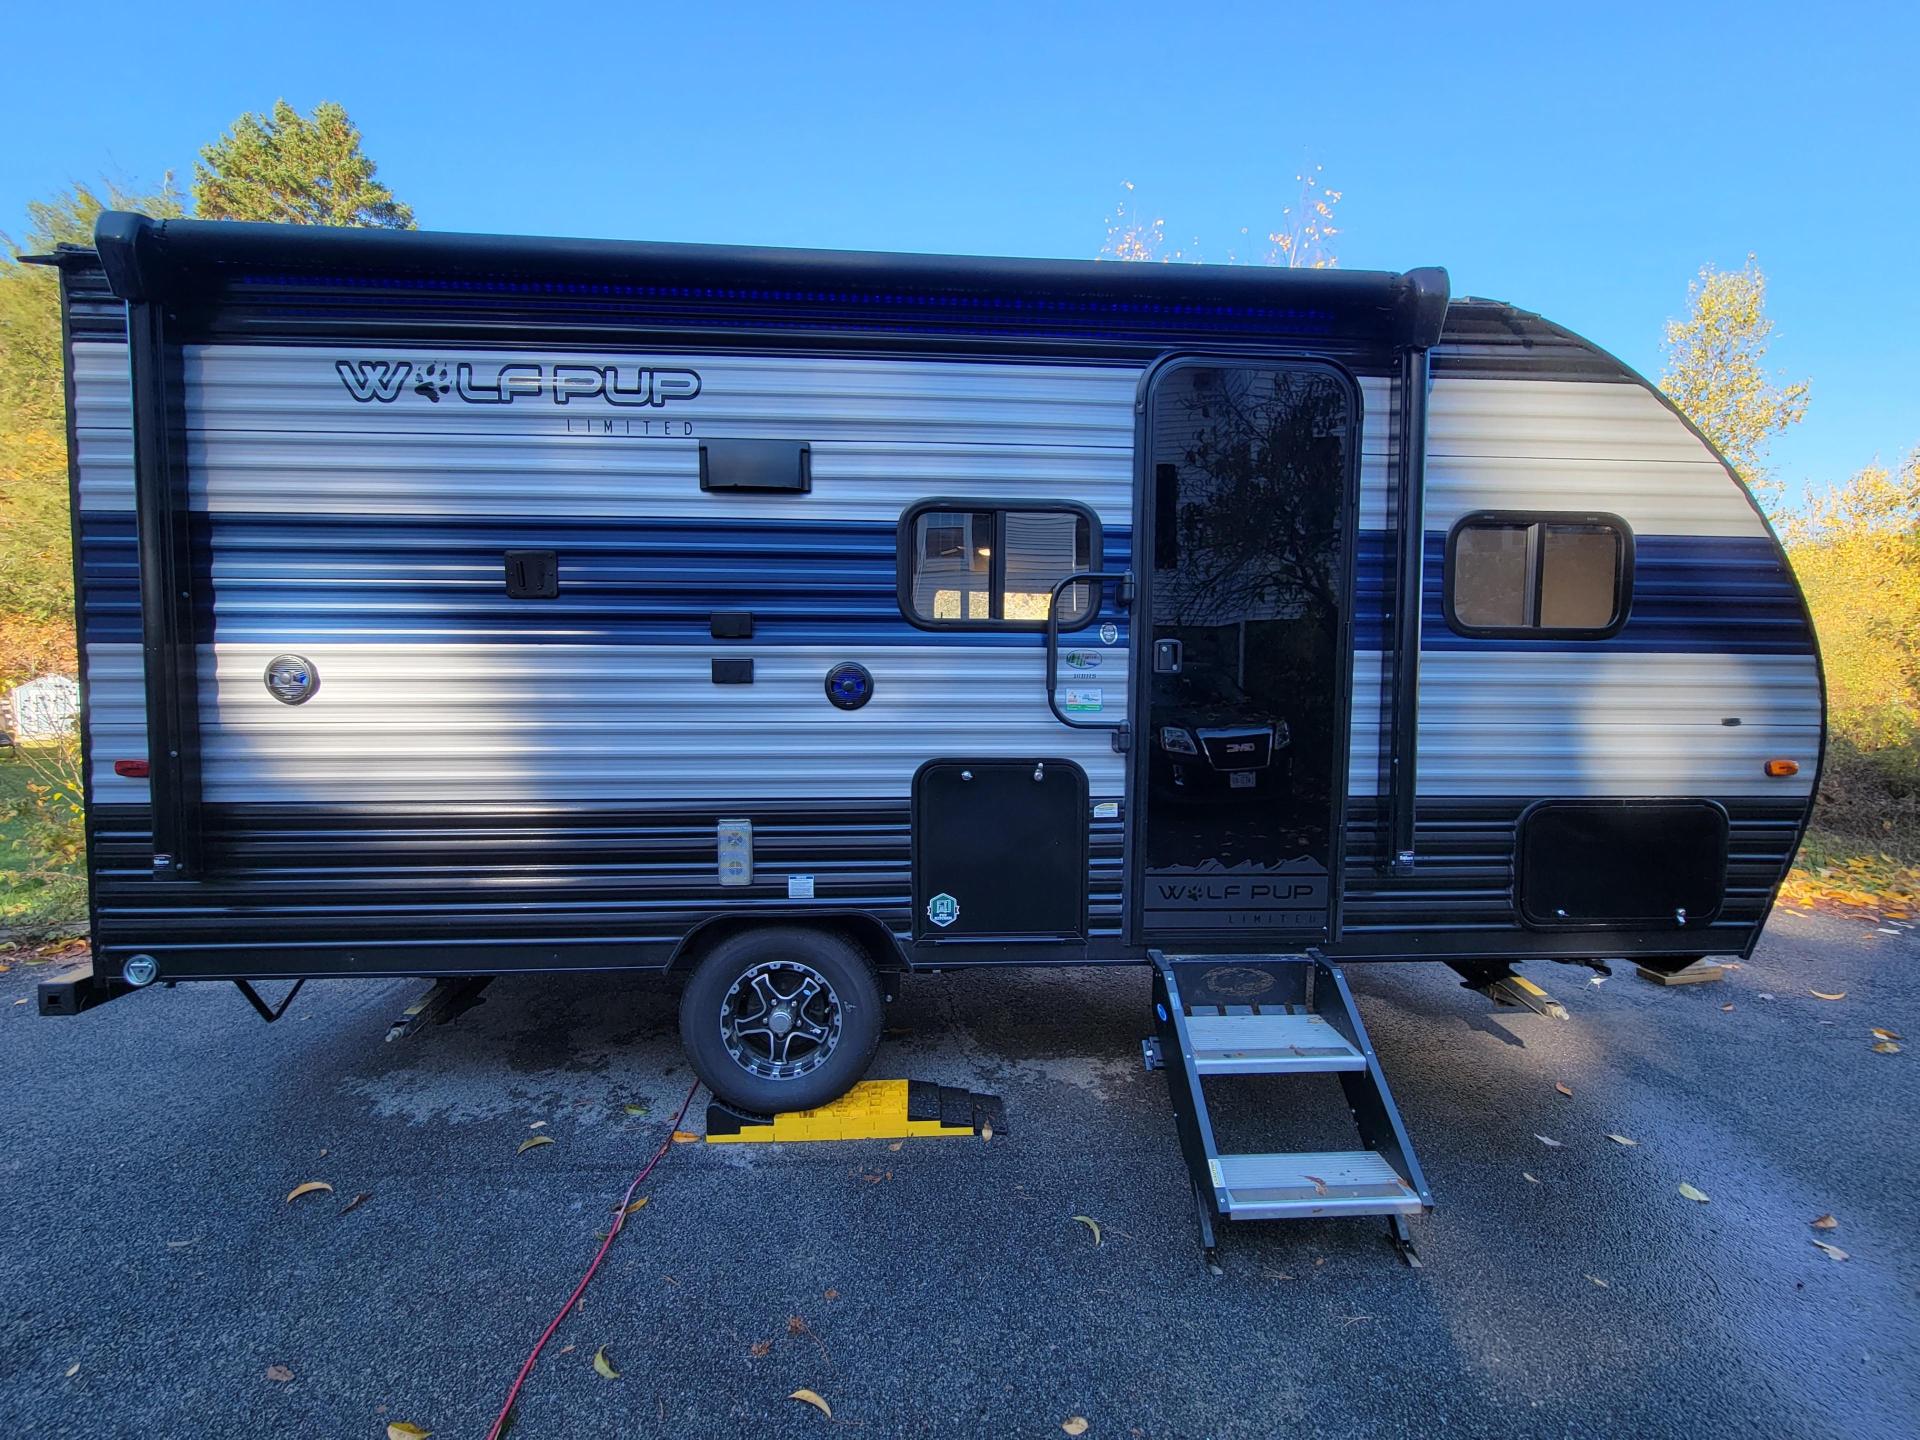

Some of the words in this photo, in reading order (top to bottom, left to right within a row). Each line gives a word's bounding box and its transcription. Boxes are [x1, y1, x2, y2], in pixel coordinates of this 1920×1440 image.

[553, 365, 702, 407] PUP
[567, 419, 693, 436] LIMITED
[1251, 885, 1314, 899] PUP
